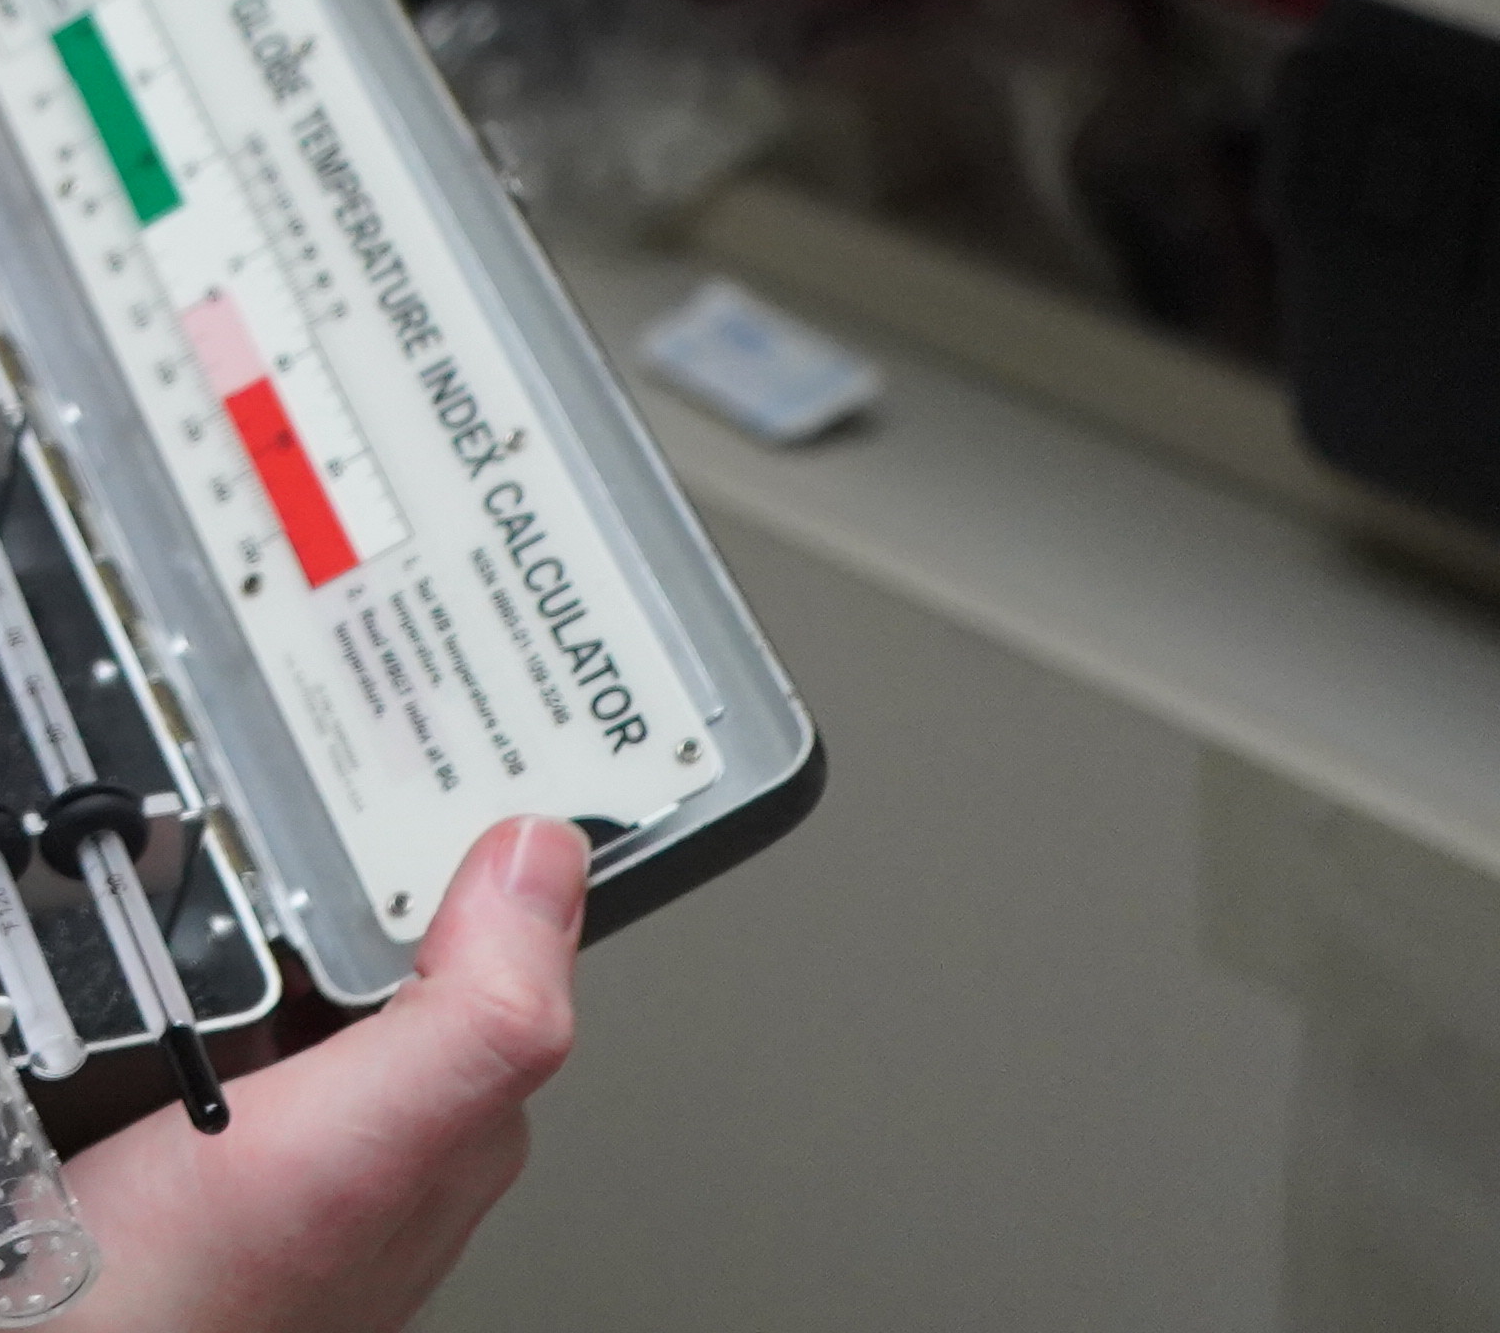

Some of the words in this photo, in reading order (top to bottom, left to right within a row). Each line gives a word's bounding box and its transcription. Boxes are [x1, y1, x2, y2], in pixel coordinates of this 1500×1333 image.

[298, 108, 440, 355] TEMPERATURE
[420, 358, 503, 477] INDEX
[484, 482, 647, 752] CALCULATOR
[470, 546, 497, 587] NSN
[442, 632, 498, 730] temperature
